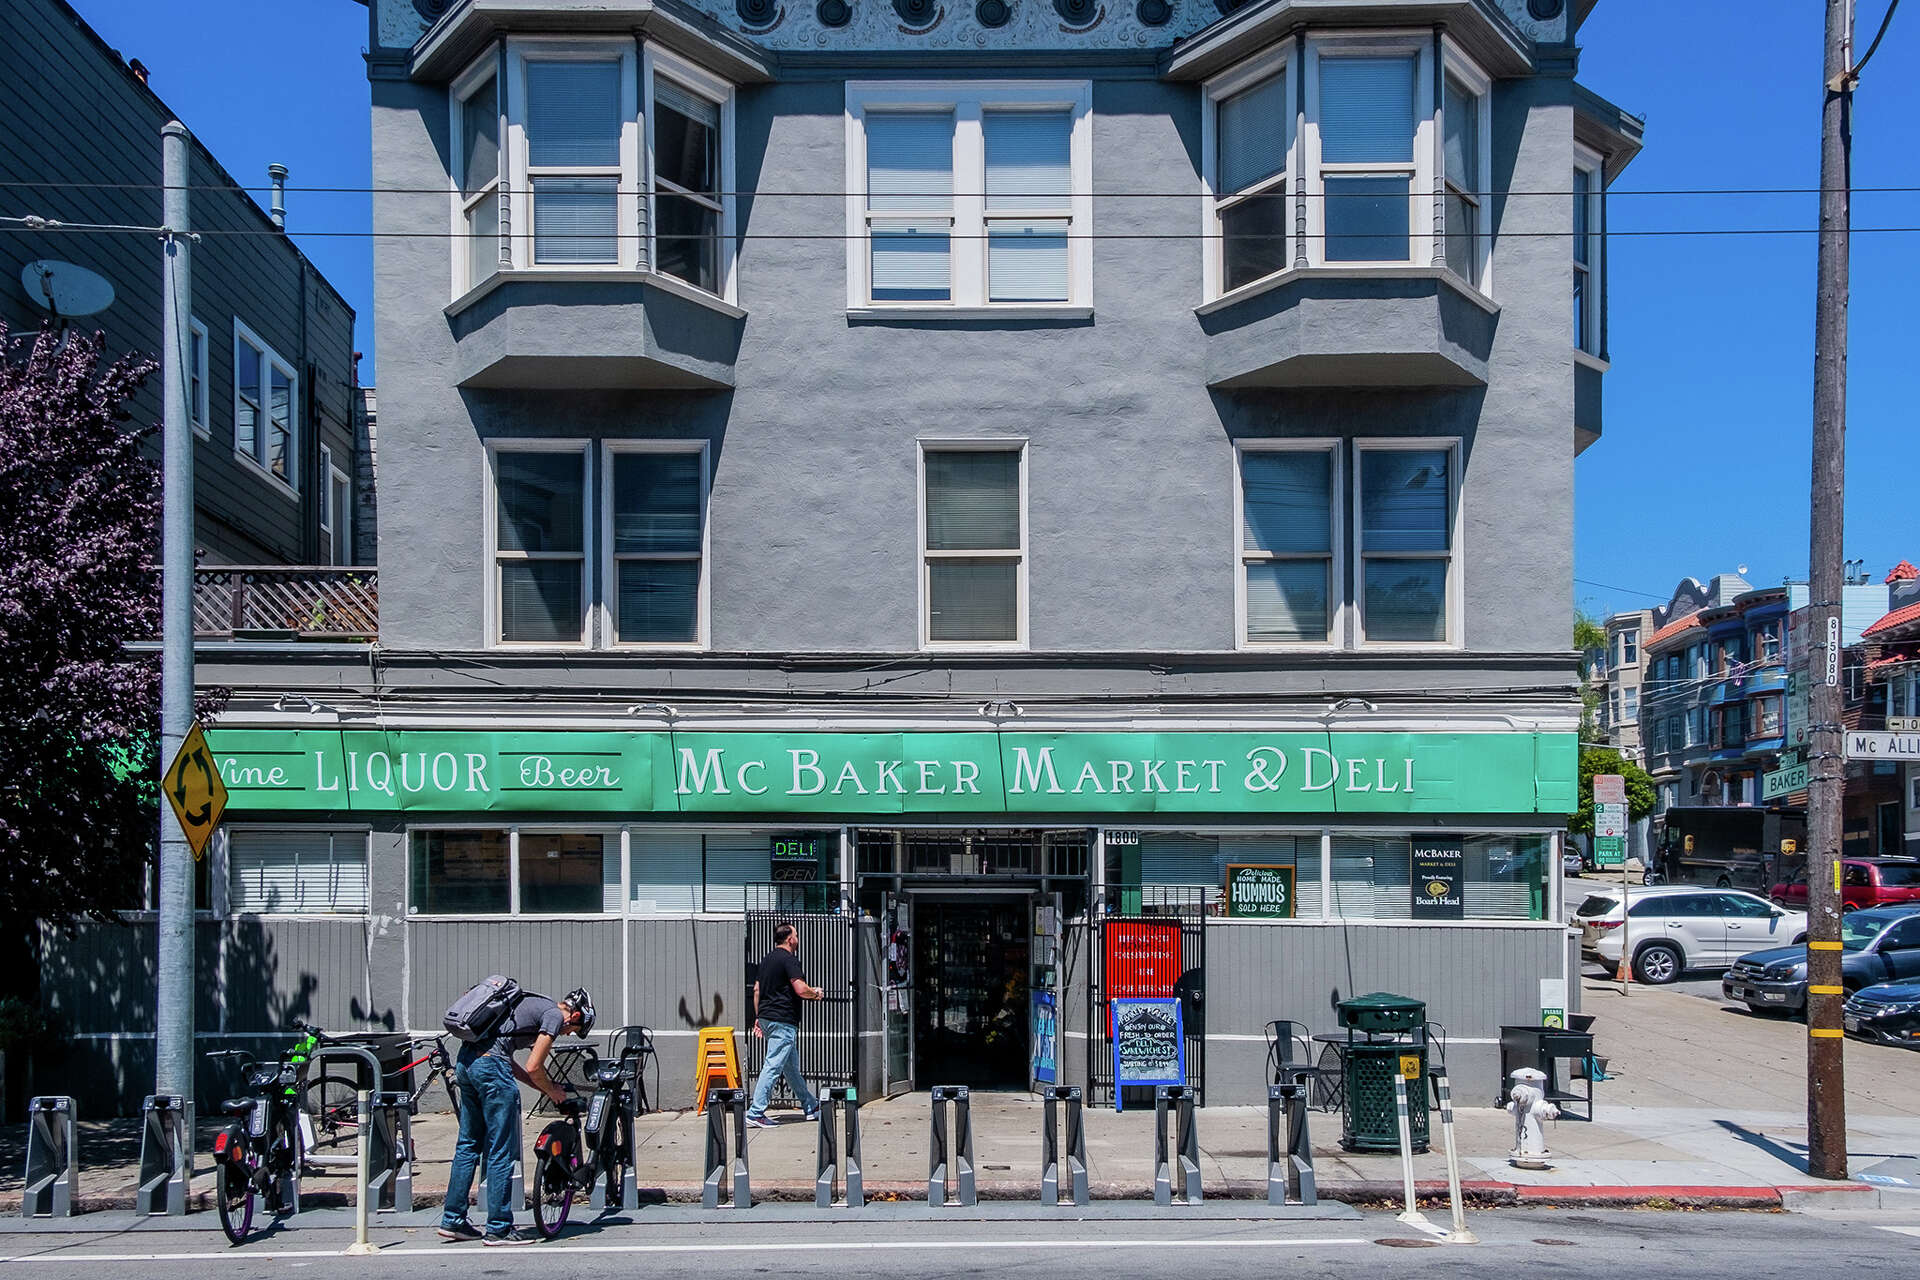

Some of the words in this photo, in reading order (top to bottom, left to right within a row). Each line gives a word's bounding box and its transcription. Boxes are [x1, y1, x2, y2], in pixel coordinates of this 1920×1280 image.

[1828, 619, 1837, 685] 815080
[315, 751, 491, 797] LIQUOR
[519, 755, 620, 788] Beer
[785, 748, 982, 795] BAKER
[1008, 746, 1228, 794] MARKET
[1244, 745, 1289, 793] &
[1300, 746, 1416, 793] DELI
[1770, 770, 1805, 792] BAKER
[1107, 831, 1137, 844] 1800
[775, 842, 813, 856] DELI
[1236, 875, 1257, 883] HOME
[1232, 882, 1286, 904] HUMMUS
[1439, 896, 1460, 905] Head
[1238, 903, 1257, 913] SOLD
[1260, 904, 1281, 913] HERE
